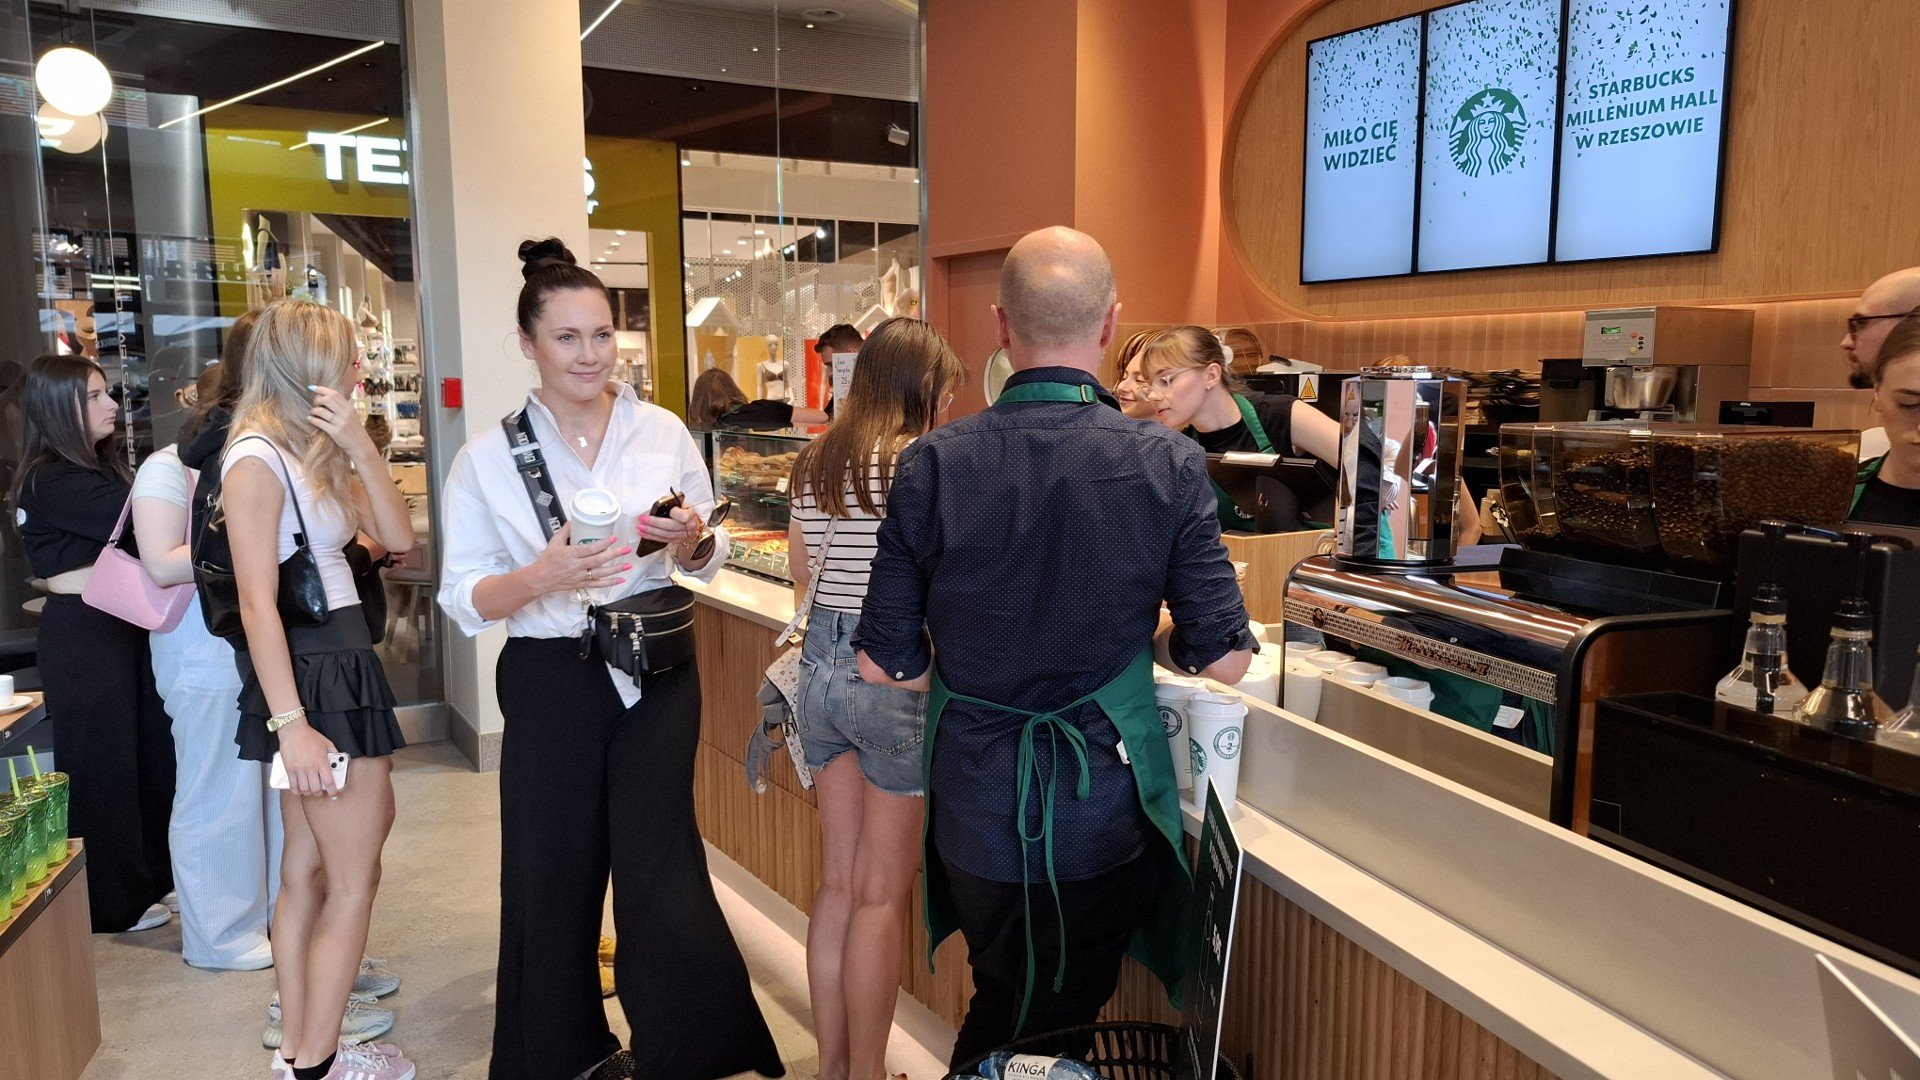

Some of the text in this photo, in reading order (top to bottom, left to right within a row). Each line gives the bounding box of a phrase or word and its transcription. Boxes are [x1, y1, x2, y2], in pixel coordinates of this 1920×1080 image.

[1588, 66, 1695, 99] STARBUCKS
[1566, 89, 1718, 127] MILLENIUM HALL
[1323, 120, 1398, 149] MIŁO CIĘ
[1575, 117, 1704, 150] W RZESZOWIE
[307, 131, 409, 185] TE
[1323, 139, 1397, 171] WIDZIEĆ
[1226, 742, 1233, 751] 2
[1007, 1061, 1046, 1077] KINGA
